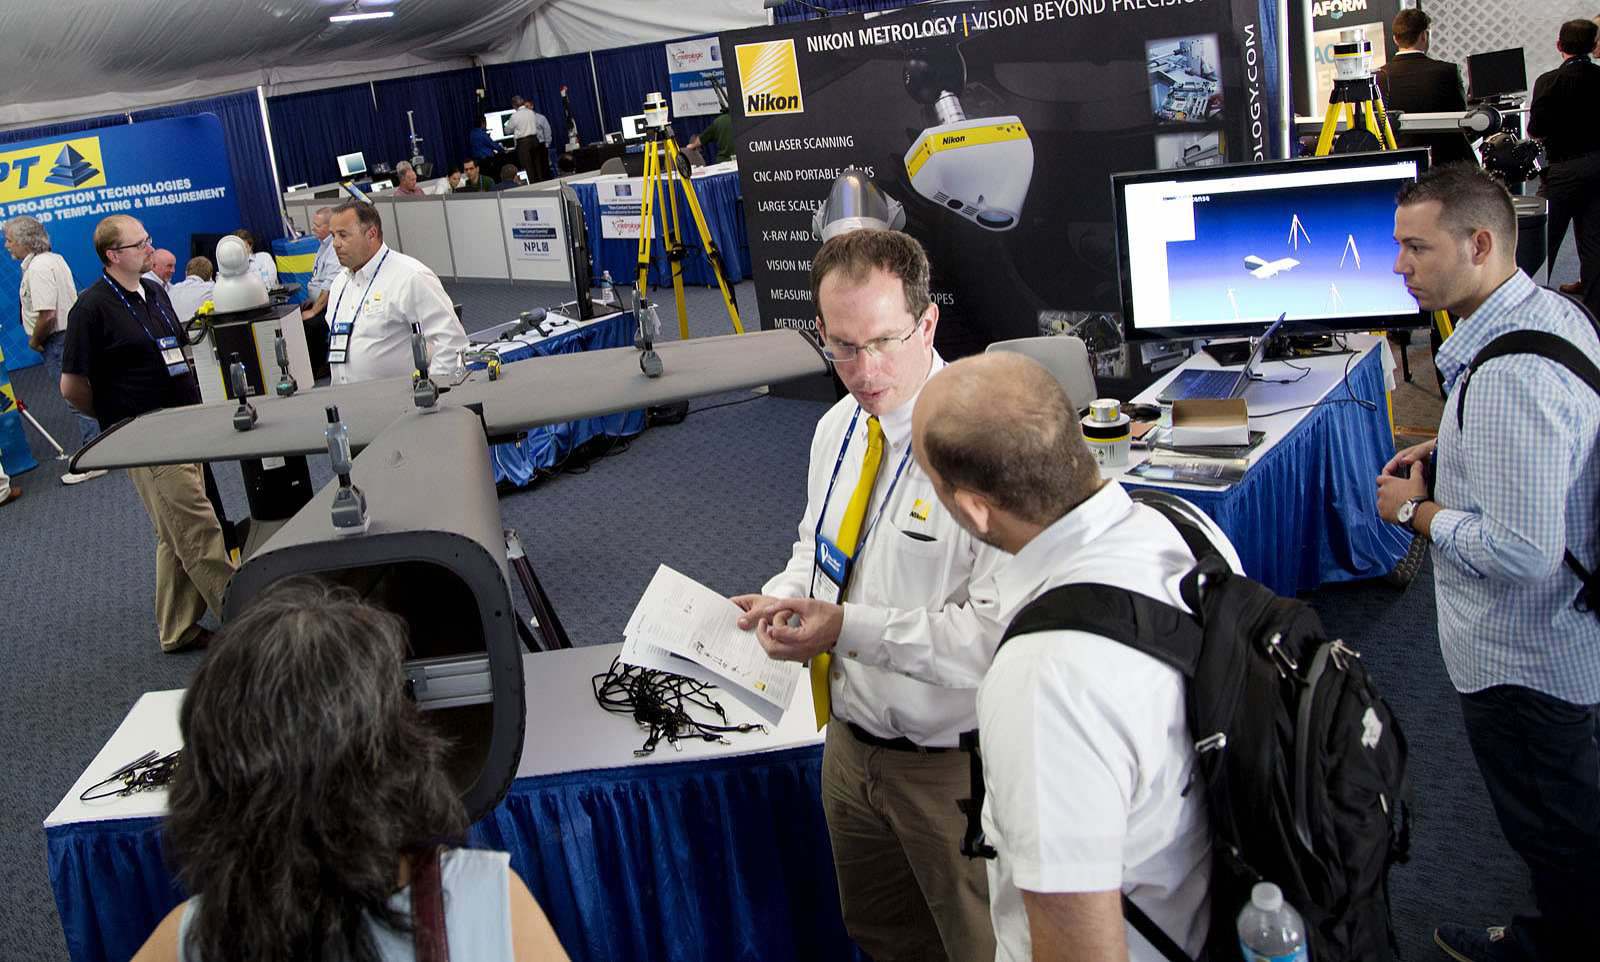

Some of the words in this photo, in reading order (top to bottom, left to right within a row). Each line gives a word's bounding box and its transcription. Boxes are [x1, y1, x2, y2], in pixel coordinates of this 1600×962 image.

[807, 31, 855, 52] NIKON
[859, 15, 957, 46] METROLOGY
[971, 6, 1029, 30] VISION
[1034, 0, 1106, 23] BEYOND
[747, 94, 799, 113] Nikon
[749, 141, 772, 153] CMM
[774, 139, 802, 151] LASER
[804, 136, 854, 149] SCANNING
[942, 134, 966, 146] Nikon
[753, 171, 773, 183] CNC
[774, 169, 794, 181] AND
[796, 167, 842, 181] PORTABLE
[8, 191, 96, 216] PROJECTION
[97, 178, 192, 200] TECHNOLOGIES
[54, 200, 132, 220] TEMPLATING
[134, 199, 143, 208] &
[145, 187, 226, 206] MEASUREMENT
[758, 200, 787, 212] LARGE
[788, 199, 817, 211] SCALE
[762, 231, 788, 242] X-RAY
[790, 230, 810, 242] AND
[524, 241, 542, 252] NPL
[766, 260, 796, 272] VISION
